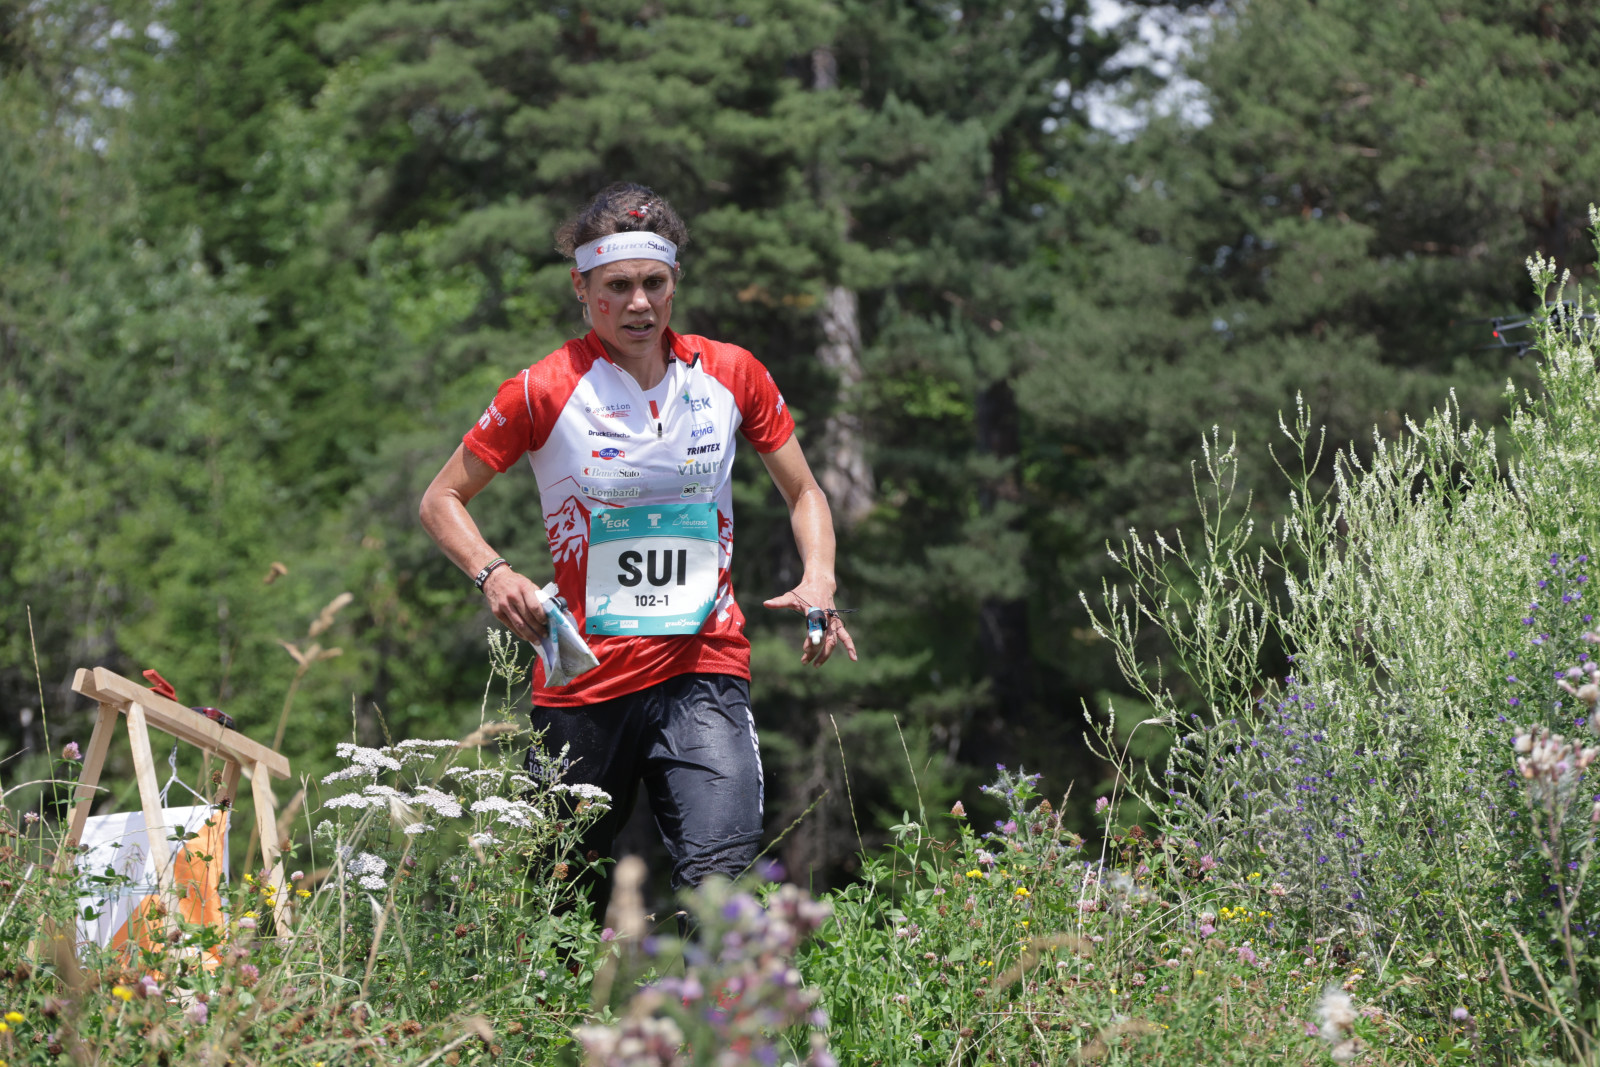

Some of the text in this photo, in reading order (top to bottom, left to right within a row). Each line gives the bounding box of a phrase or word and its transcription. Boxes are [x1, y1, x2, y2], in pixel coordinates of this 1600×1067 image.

[691, 426, 713, 438] KPMG
[687, 443, 721, 455] TRIMTEX
[591, 467, 640, 478] BancaStato
[592, 487, 639, 497] Lombardi
[606, 518, 630, 529] EGK
[617, 549, 687, 587] SUI
[635, 594, 669, 607] 102-1
